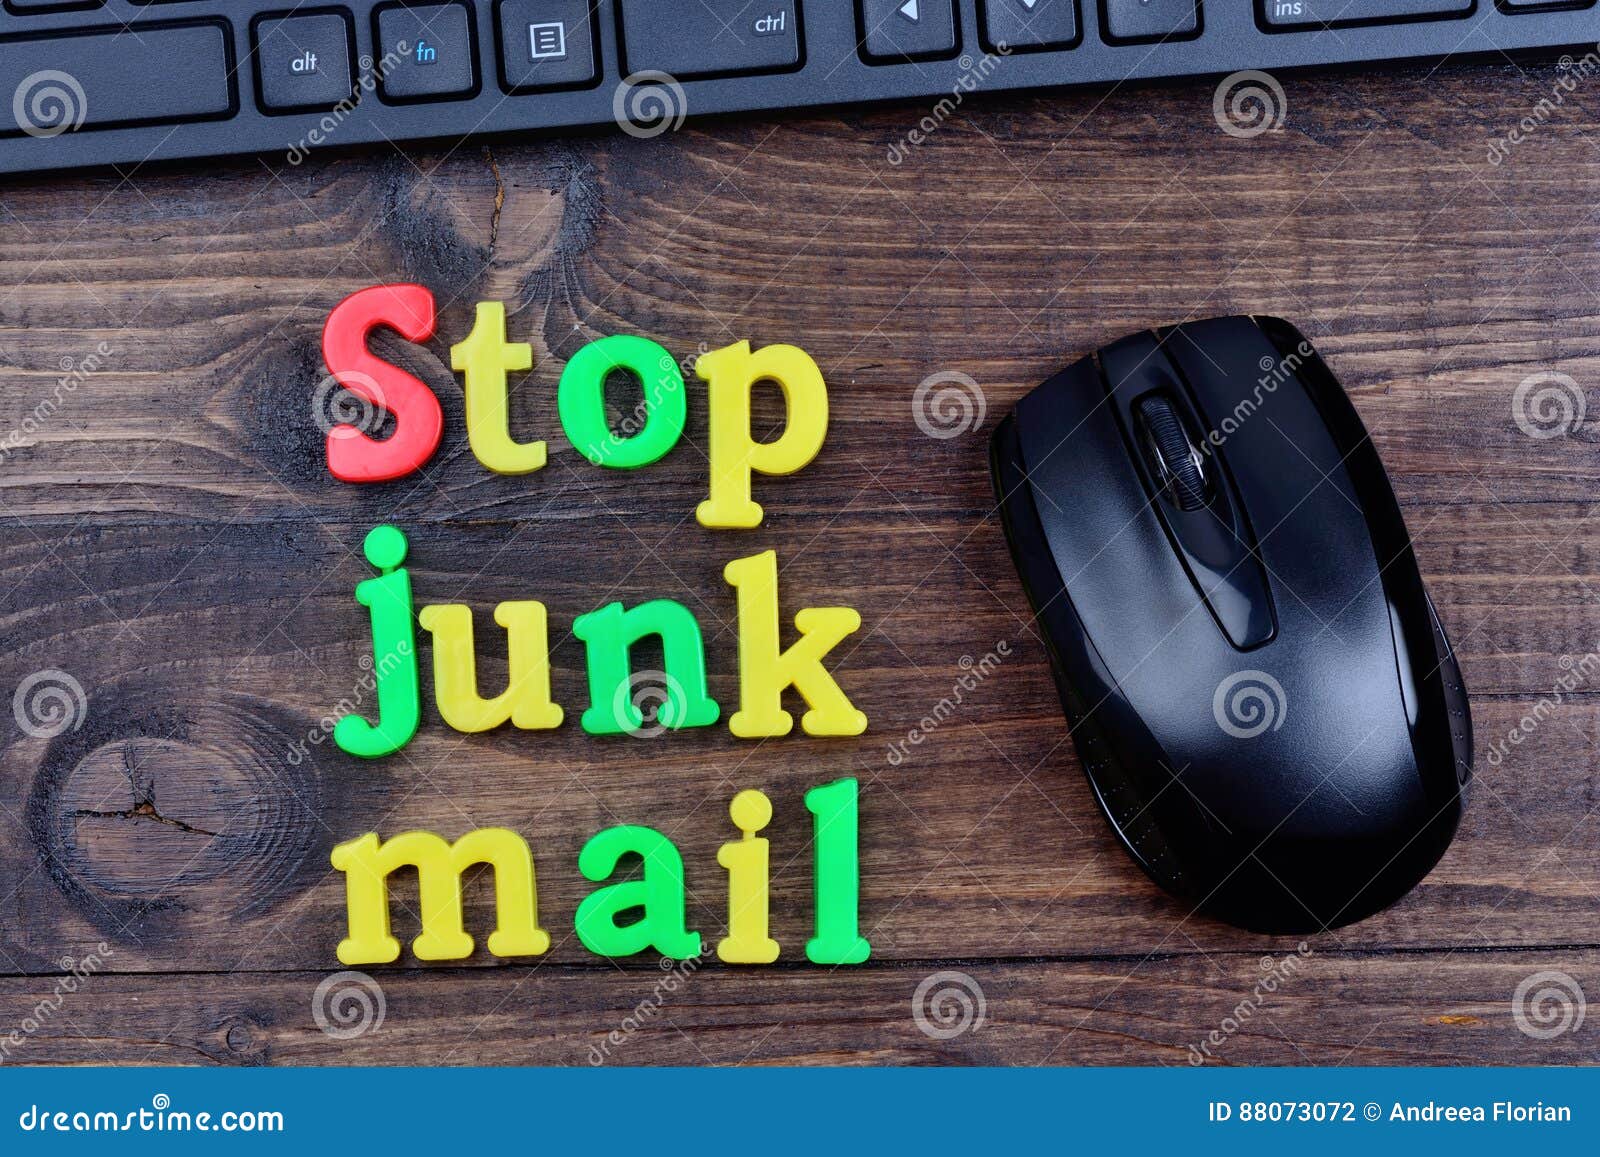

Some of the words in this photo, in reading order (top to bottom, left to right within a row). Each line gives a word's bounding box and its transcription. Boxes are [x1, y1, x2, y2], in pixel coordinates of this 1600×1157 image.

[1276, 0, 1302, 17] ins
[755, 11, 785, 32] ctrl
[291, 51, 317, 72] alt
[416, 42, 435, 61] fn
[322, 283, 830, 528] Stop
[334, 525, 868, 759] junk
[331, 777, 872, 965] mail
